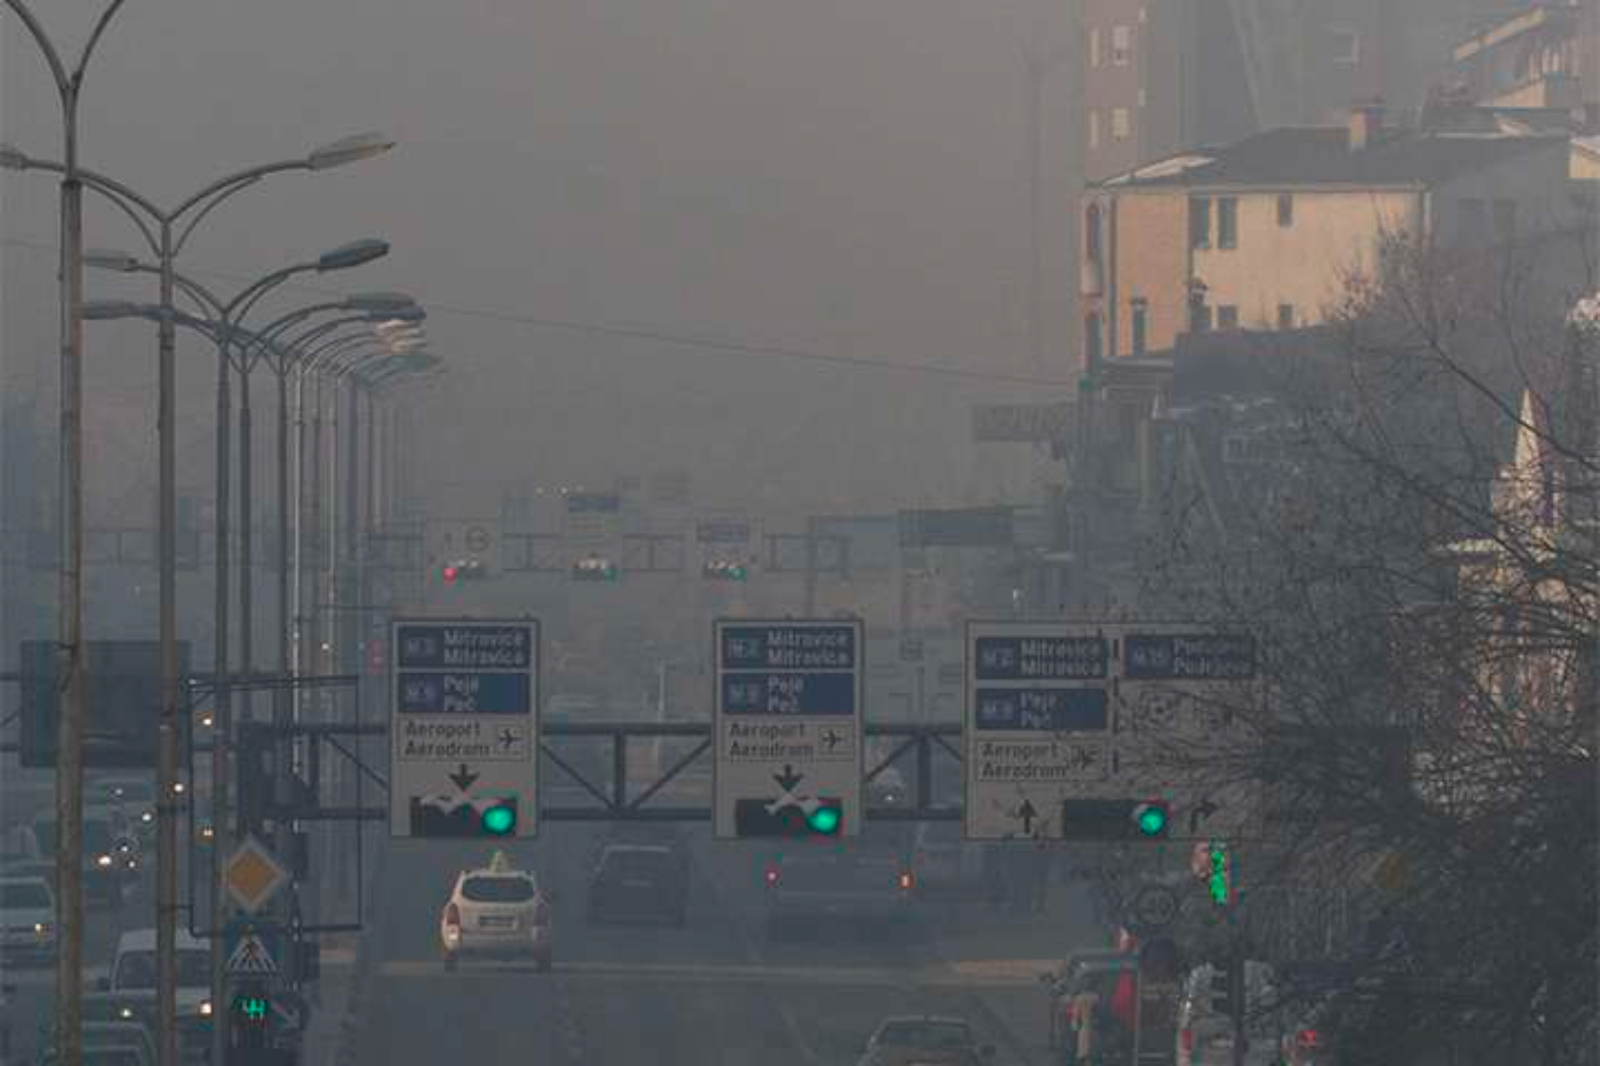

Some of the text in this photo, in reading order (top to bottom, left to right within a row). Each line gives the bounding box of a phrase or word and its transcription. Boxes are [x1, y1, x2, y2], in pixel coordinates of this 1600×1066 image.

[405, 720, 481, 738] Aeroport
[729, 722, 805, 740] Aeroport
[405, 740, 490, 755] Aerodrom
[729, 741, 814, 756] Aerodrom
[982, 743, 1058, 760] Aeroport
[982, 762, 1066, 777] Aerodrom
